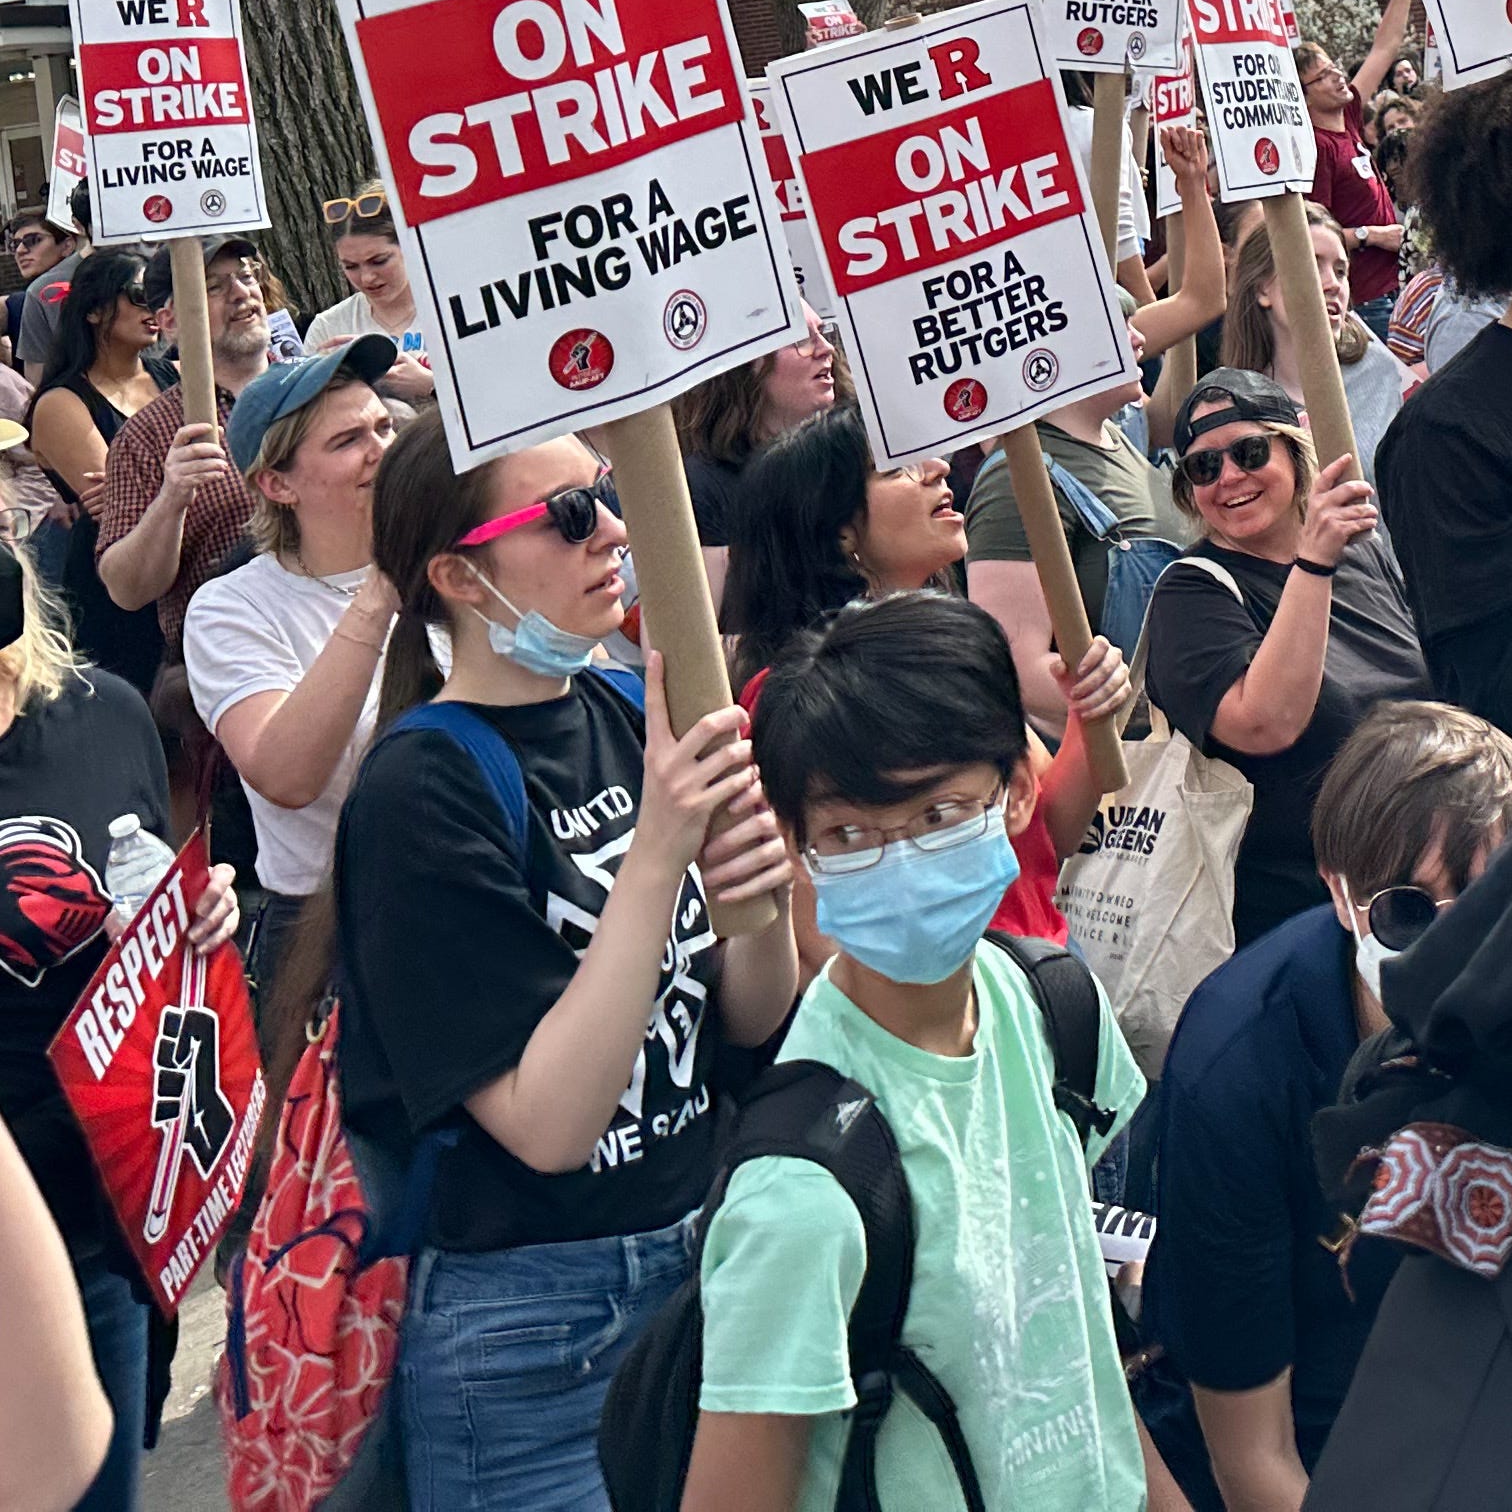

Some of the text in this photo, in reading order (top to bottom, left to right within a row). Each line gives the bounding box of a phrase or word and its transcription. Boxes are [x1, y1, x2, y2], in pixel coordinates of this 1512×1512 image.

[1065, 1, 1158, 29] RUTGERS
[137, 46, 201, 84] ON
[847, 36, 992, 117] WE R
[1212, 79, 1283, 104] STUDENT
[1233, 54, 1267, 77] FOR
[94, 82, 243, 127] STRIKE
[408, 35, 726, 198] STRIKE
[102, 160, 187, 188] LIVING
[191, 157, 250, 180] WAGE
[142, 137, 216, 163] FOR A
[895, 115, 991, 193] ON
[527, 178, 676, 261] FOR A
[838, 152, 1069, 277] STRIKE
[448, 194, 758, 339] LIVING WAGE
[921, 250, 1026, 310] FOR A
[908, 301, 1069, 386] RUTGERS
[912, 274, 1050, 349] BETTER
[75, 870, 189, 1081] RESPECT
[159, 1174, 235, 1303] PART-TIME
